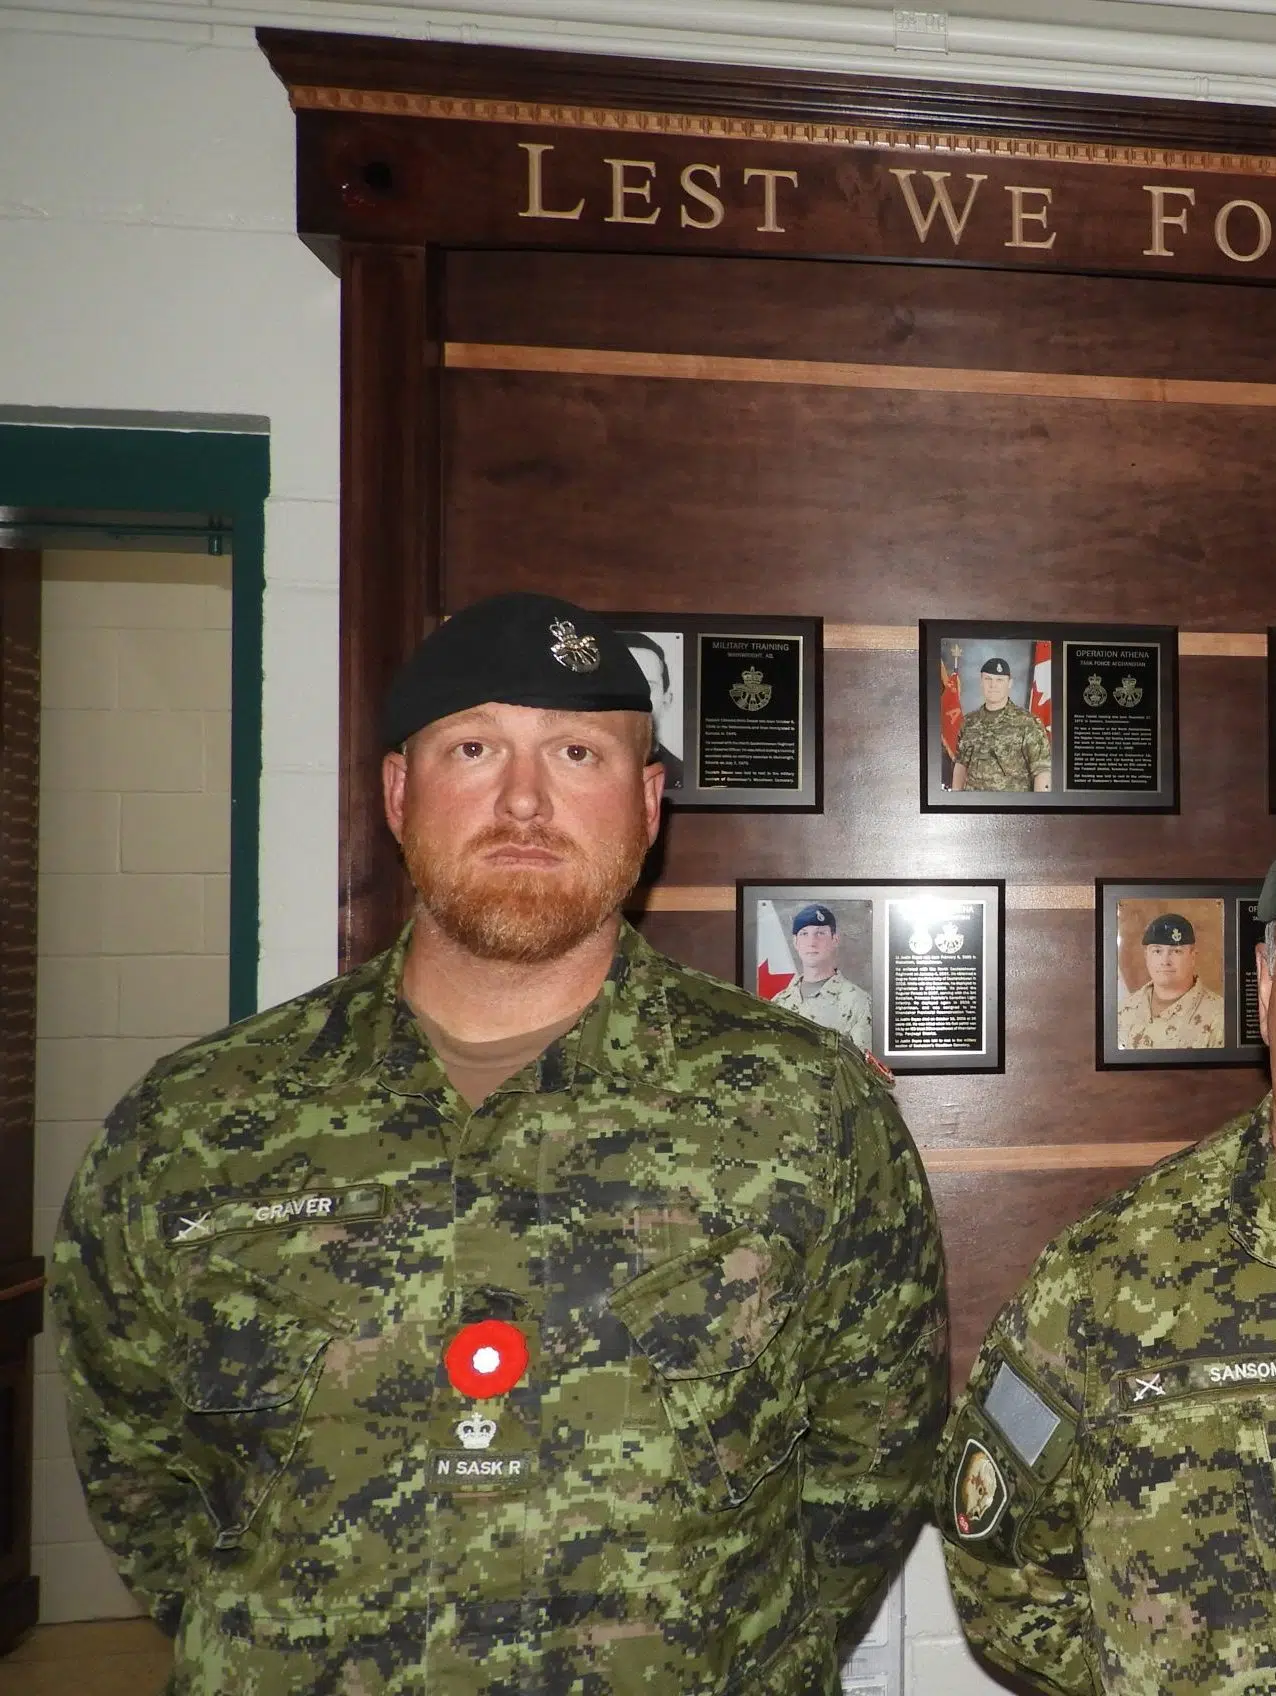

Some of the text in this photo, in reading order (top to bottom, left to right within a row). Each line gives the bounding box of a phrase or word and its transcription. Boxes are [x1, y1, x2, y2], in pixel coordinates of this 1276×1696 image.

[517, 143, 798, 232] LEST
[888, 168, 1057, 250] WE
[712, 640, 790, 651] MILITARY TRAINING
[1076, 649, 1150, 659] OPERATION ATHENA
[255, 1197, 333, 1221] GRAVER
[437, 1460, 521, 1475] N SASK R
